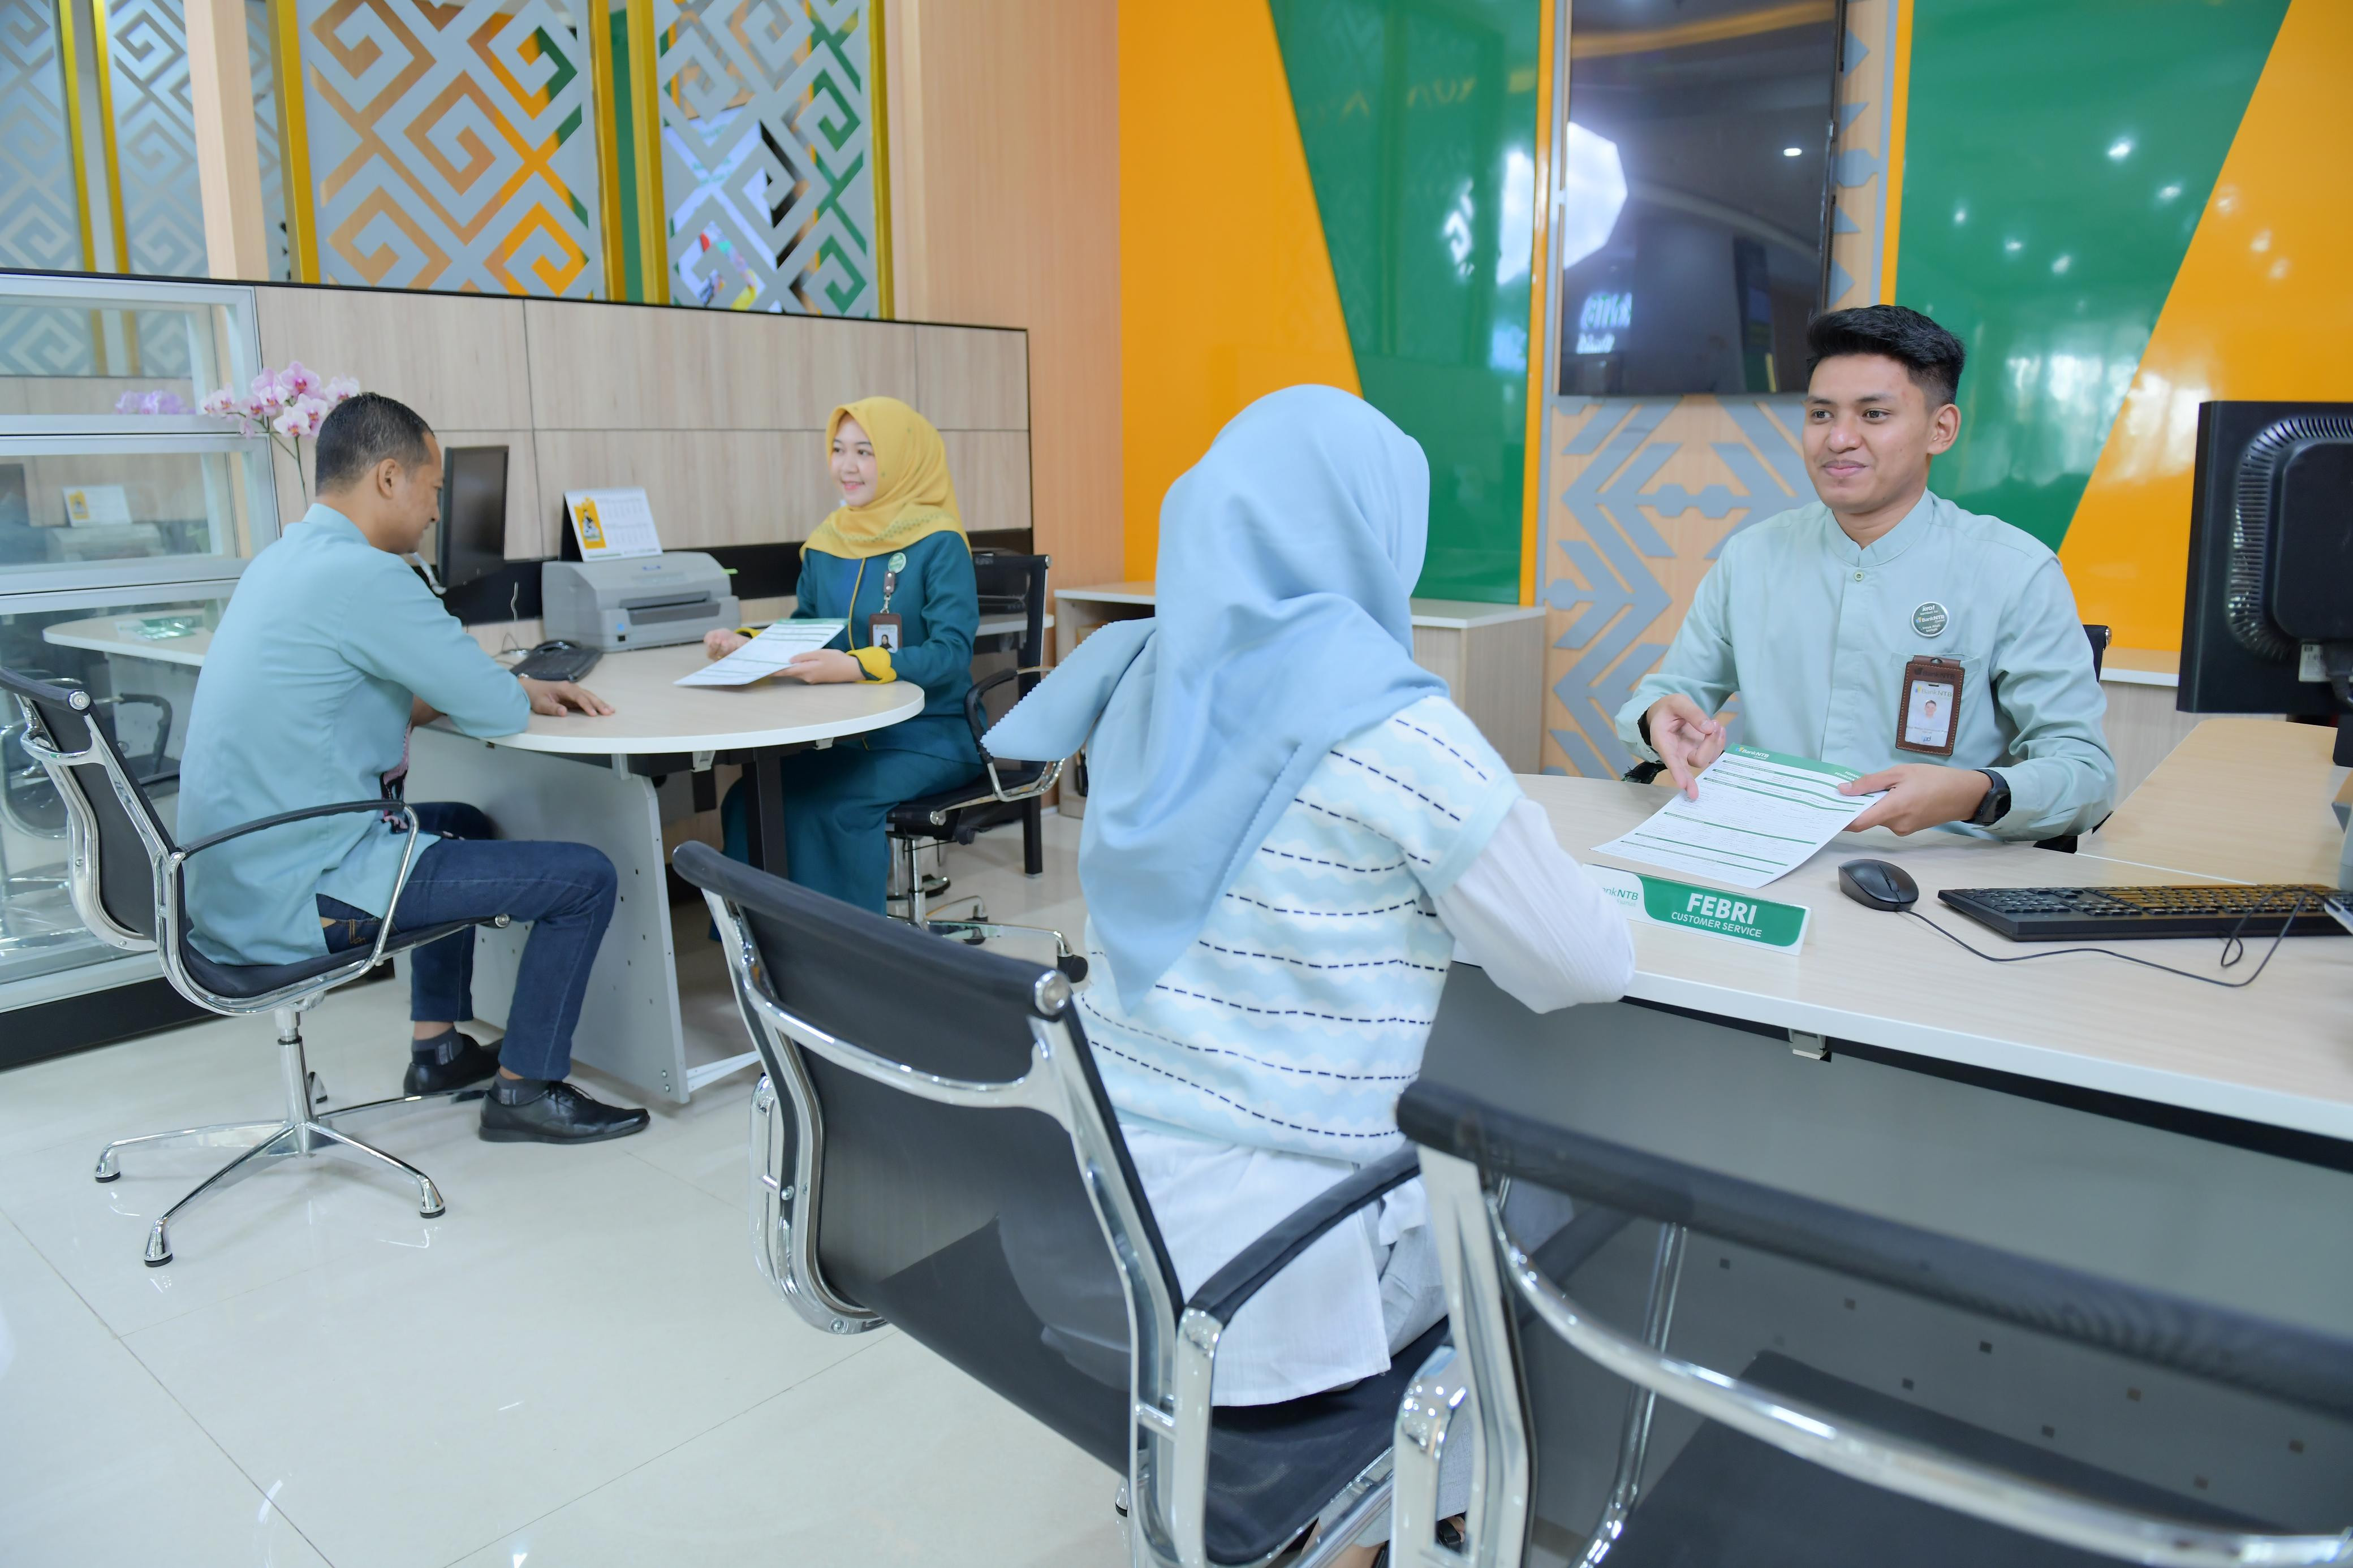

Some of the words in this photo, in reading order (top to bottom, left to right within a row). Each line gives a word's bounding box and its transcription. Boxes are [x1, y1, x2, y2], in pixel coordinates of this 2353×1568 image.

[1742, 749, 1769, 758] BankNTB
[1687, 893, 1757, 925] FEBRI
[1671, 912, 1721, 929] CUSTOMER
[1722, 922, 1762, 938] SERVICE
